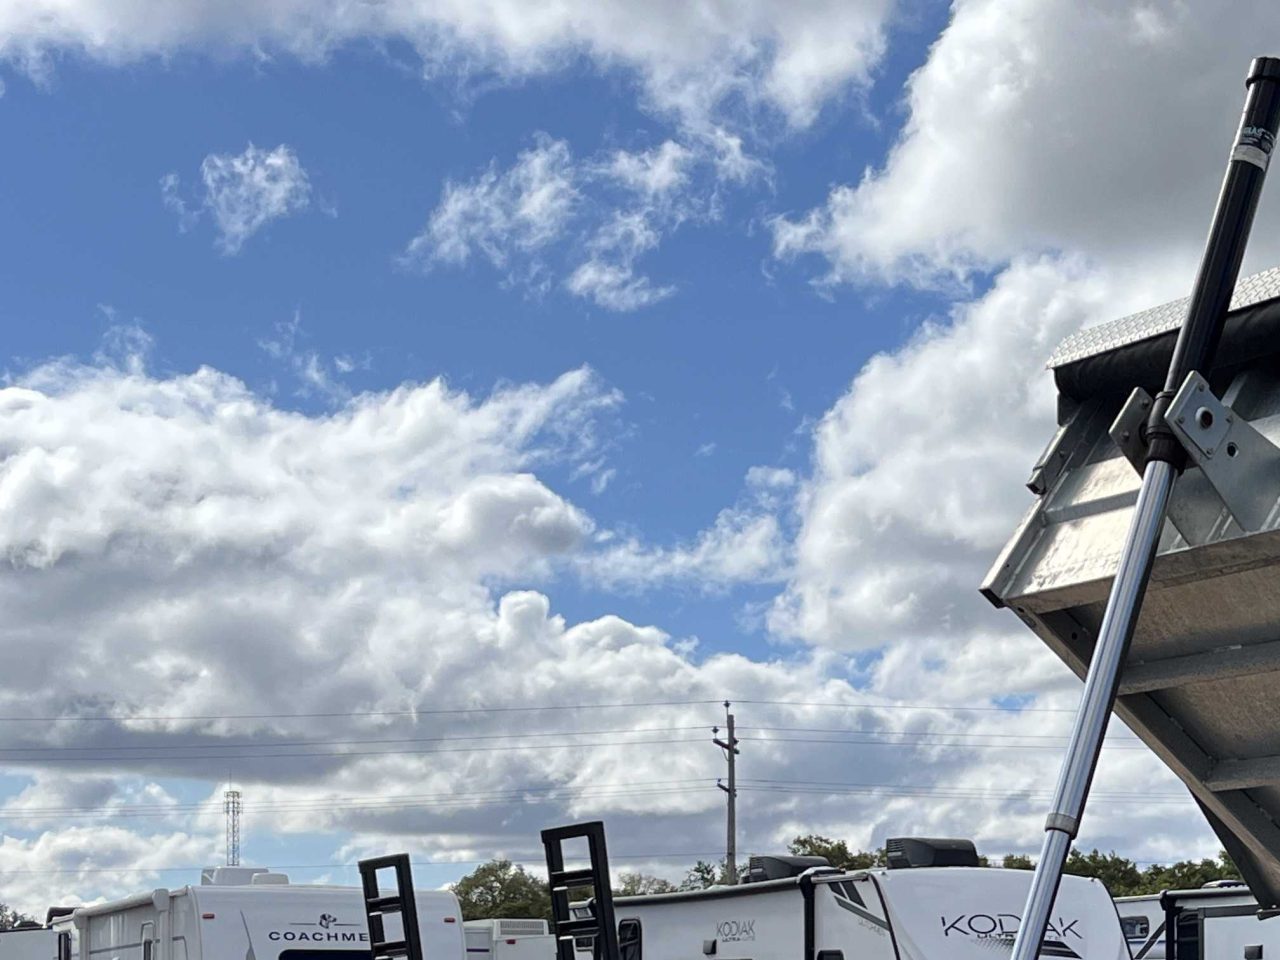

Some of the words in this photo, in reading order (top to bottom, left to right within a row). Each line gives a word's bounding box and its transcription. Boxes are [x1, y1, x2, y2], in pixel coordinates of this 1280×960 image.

[715, 919, 755, 937] KODIAK
[941, 914, 1083, 939] KODAK
[268, 931, 369, 942] COACHME
